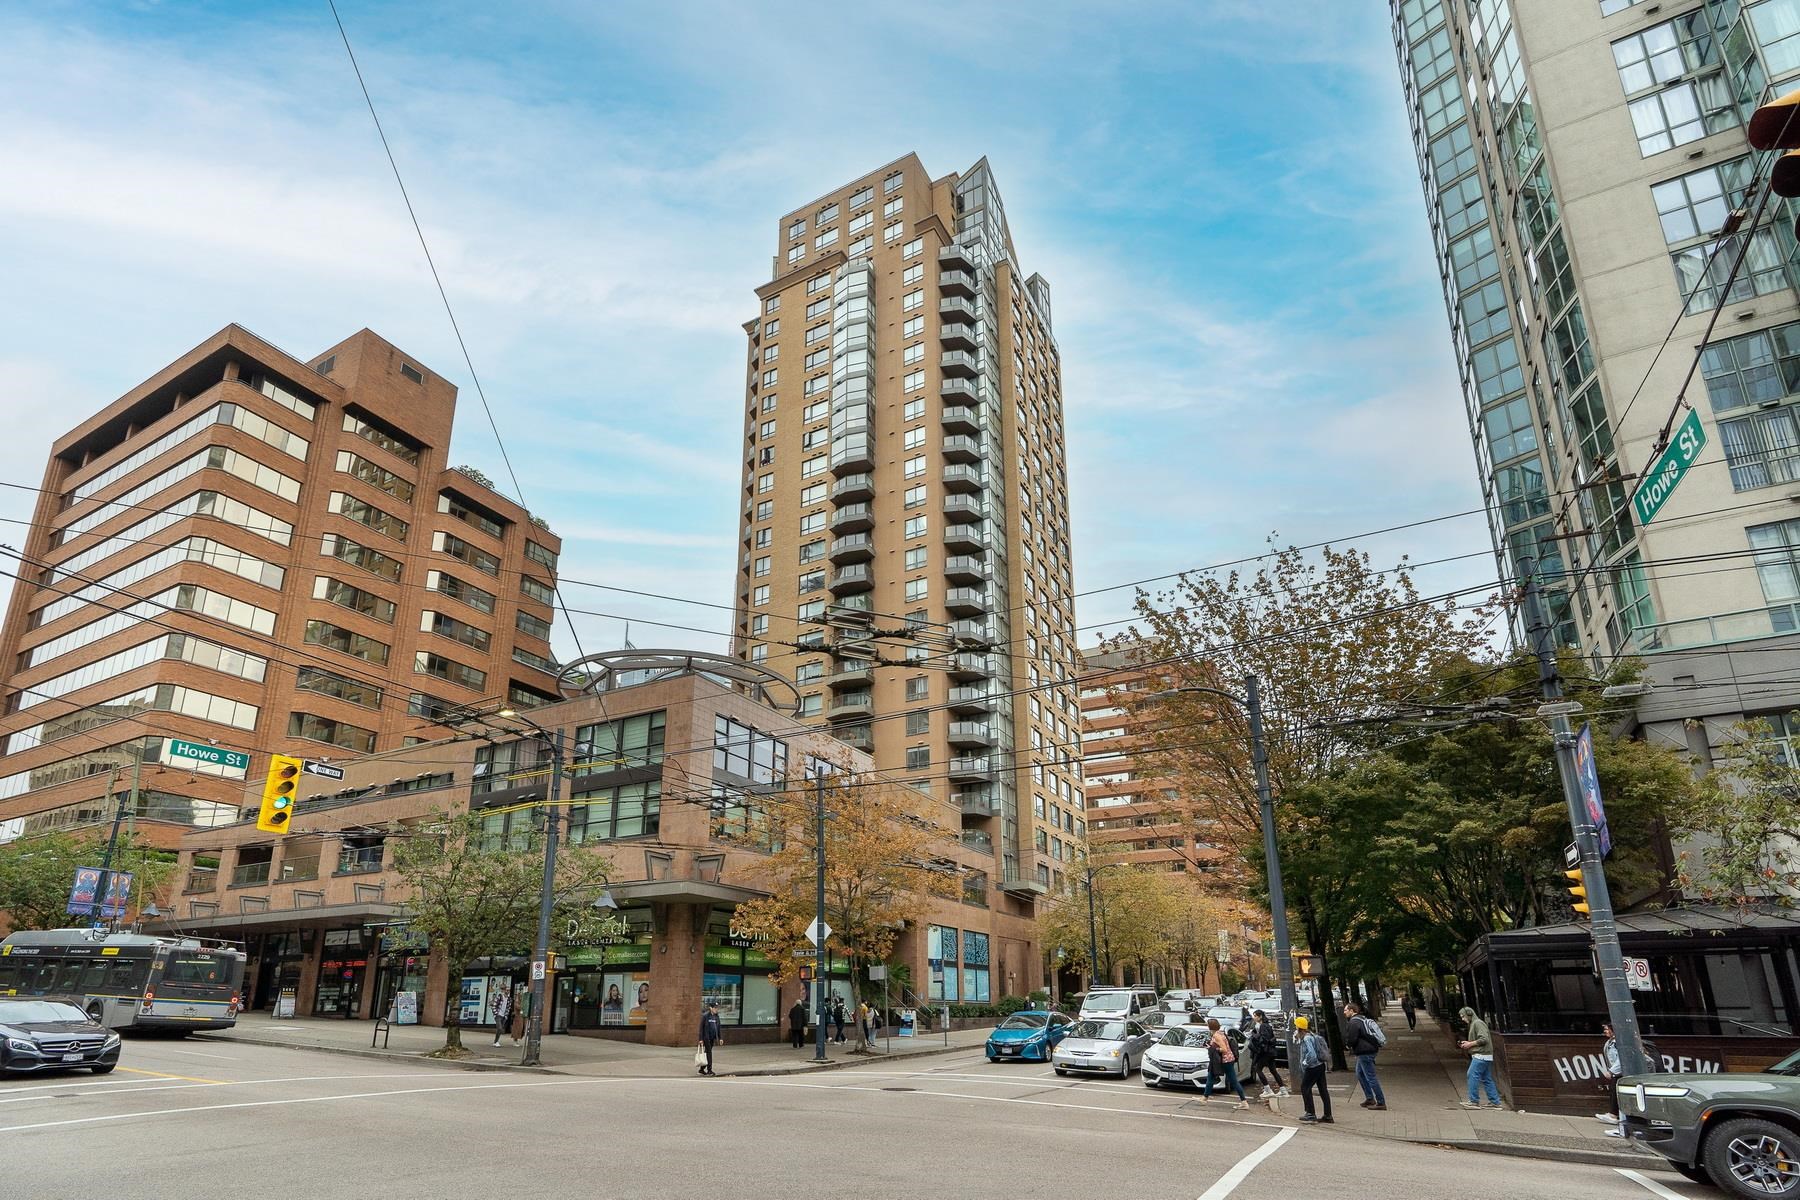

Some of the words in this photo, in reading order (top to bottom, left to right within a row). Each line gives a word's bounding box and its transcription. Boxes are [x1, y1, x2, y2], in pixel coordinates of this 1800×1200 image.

[1640, 459, 1679, 516] Howe
[1679, 425, 1699, 461] St
[177, 743, 219, 761] Howe
[225, 753, 241, 766] St
[328, 768, 340, 777] WAY
[208, 971, 216, 979] 6
[1553, 1053, 1608, 1083] HON
[1661, 1055, 1720, 1074] REW
